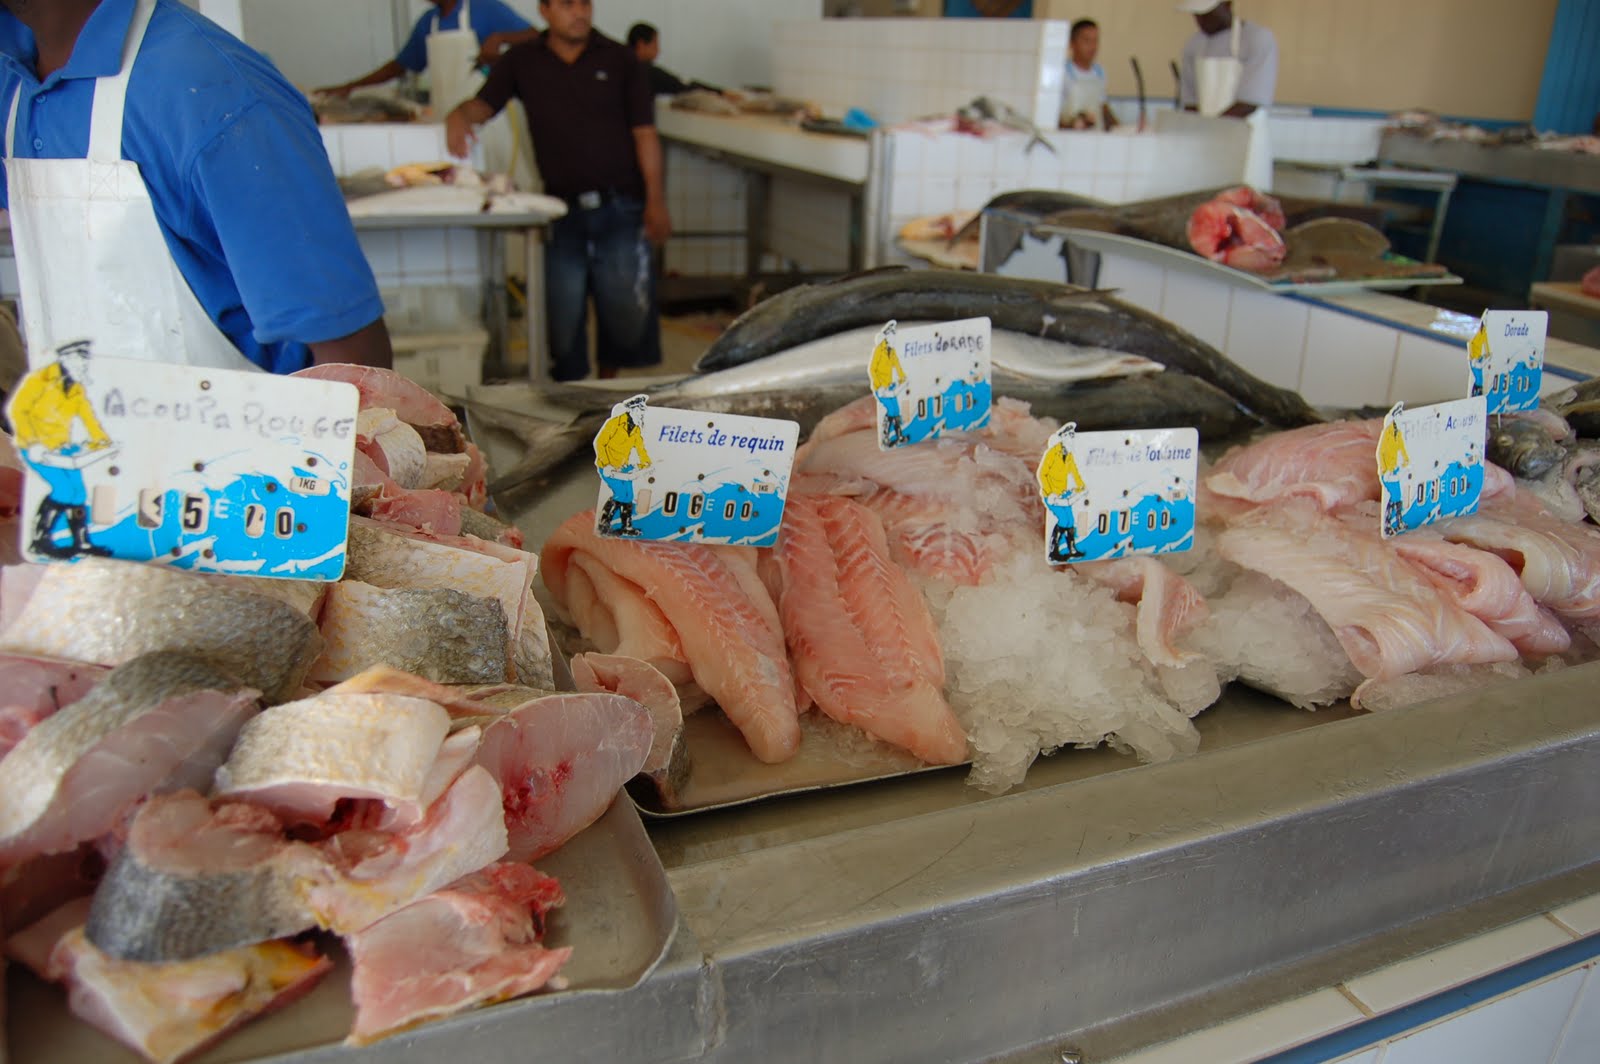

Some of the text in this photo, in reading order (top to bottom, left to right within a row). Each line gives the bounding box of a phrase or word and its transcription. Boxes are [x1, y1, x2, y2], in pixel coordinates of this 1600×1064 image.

[1504, 323, 1529, 337] Dorade
[904, 341, 933, 358] Filets
[658, 425, 785, 453] Filets de requin
[298, 477, 317, 491] 1KG
